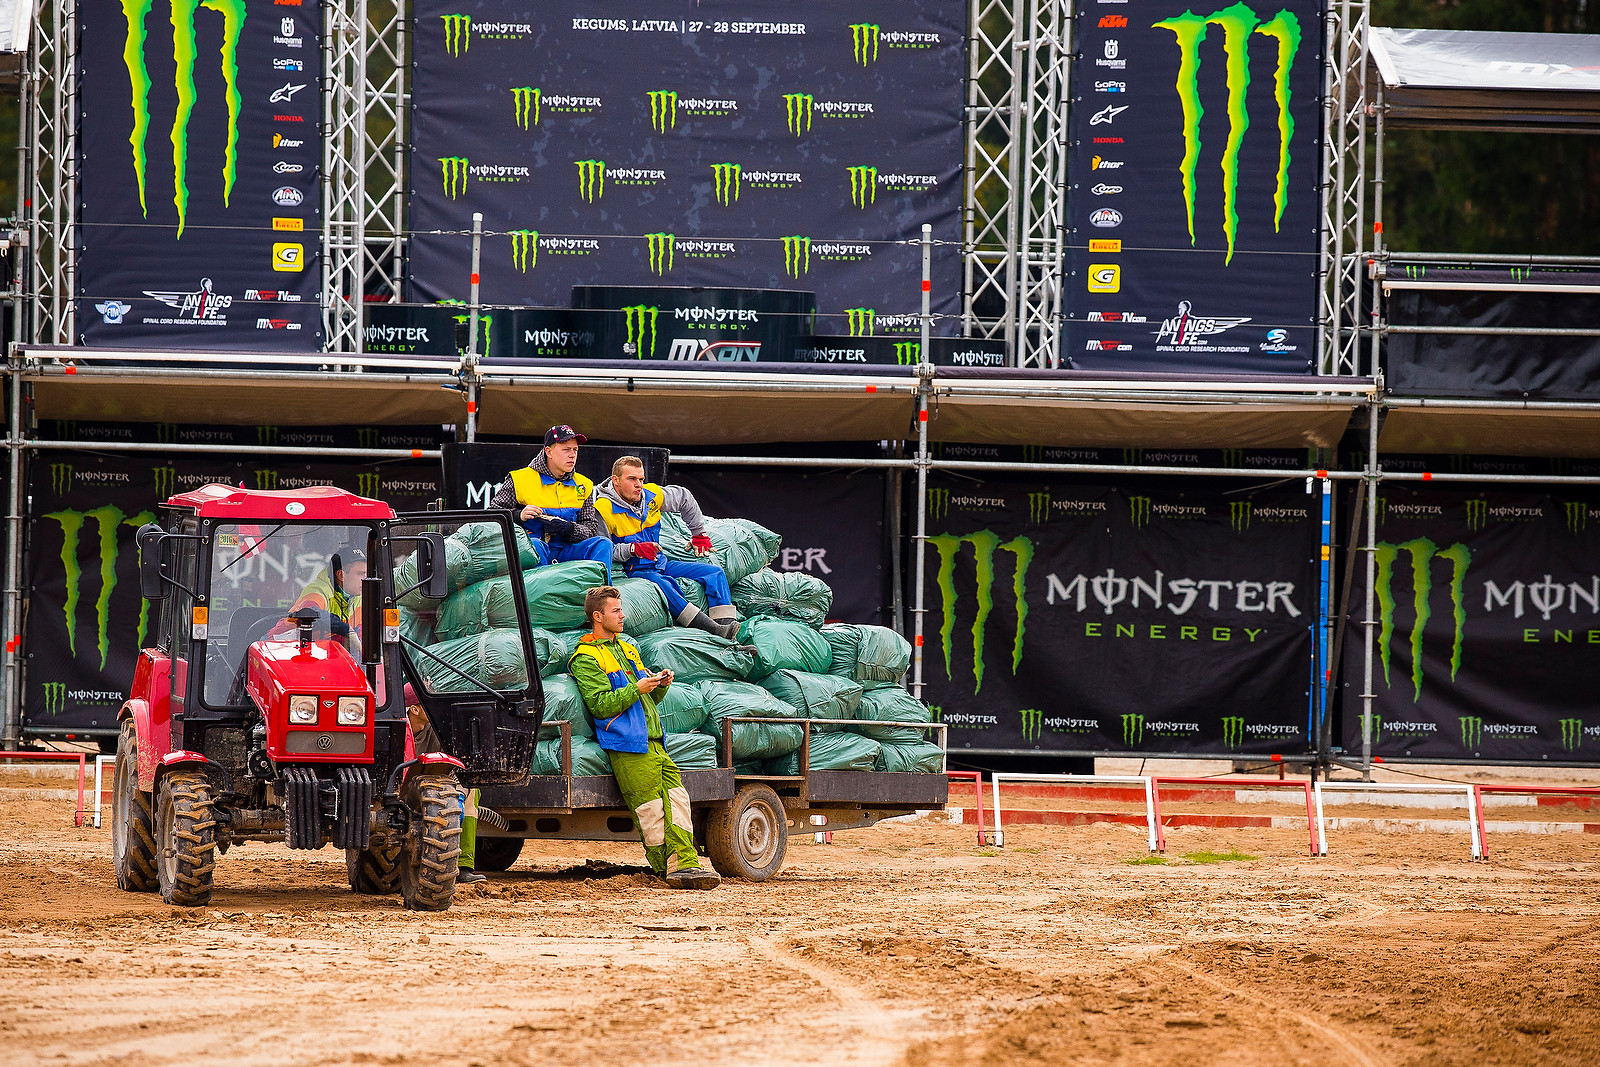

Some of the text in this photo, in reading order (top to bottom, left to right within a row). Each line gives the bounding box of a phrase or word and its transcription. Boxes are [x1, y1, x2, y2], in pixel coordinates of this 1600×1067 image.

[572, 19, 629, 32] KEGUMS,
[632, 20, 678, 31] LATVIA
[688, 22, 703, 32] 27
[714, 22, 729, 33] 28
[731, 22, 806, 34] SEPTEMBER
[1097, 15, 1128, 28] KTM
[472, 21, 532, 34] MONSTER
[881, 31, 940, 43] MONSTER
[273, 58, 303, 66] GoPro
[542, 95, 602, 107] MONSTER
[678, 98, 737, 110] MONSTER
[814, 101, 874, 113] MONSTER
[470, 165, 529, 177] MONSTER
[606, 168, 666, 180] MONSTER
[742, 171, 802, 182] MONSTER
[878, 174, 938, 185] MONSTER
[539, 238, 599, 249] MONSTER
[676, 241, 735, 252] MONSTER
[812, 243, 871, 255] MONSTER
[193, 307, 219, 319] LIFE
[675, 306, 758, 322] MONSTER
[875, 316, 935, 327] MONSTR
[1170, 332, 1200, 345] LIFE
[368, 344, 415, 352] ENERGY
[79, 427, 133, 438] MONSTER
[180, 430, 233, 441] MONSTER
[280, 433, 334, 444] MONSTER
[381, 435, 434, 446] MONSTER
[945, 446, 999, 457] MONSTER
[1045, 449, 1099, 460] MONSTER
[1145, 452, 1199, 463] MONSTER
[1245, 455, 1299, 466] MONSTER
[75, 471, 130, 482] MONSTER
[177, 474, 232, 485] MONSTER
[280, 477, 333, 487] MONSTER
[382, 480, 436, 491] MONSTER
[951, 496, 1005, 507] MONSTER
[1053, 500, 1106, 511] MONSTER
[1153, 504, 1206, 515] MONSTER
[1254, 507, 1307, 518] MONSTER
[1389, 504, 1442, 514] MONSTER
[1489, 506, 1543, 517] MONSTER
[1046, 568, 1301, 618] MONSTER
[1085, 622, 1261, 642] ENERGY
[68, 690, 123, 701] MONSTER
[944, 712, 997, 725] MONSTER
[1044, 716, 1099, 729] MONSTER
[1146, 720, 1199, 732] MONSTER
[1246, 723, 1300, 735] MONSTER
[1383, 721, 1437, 732] MONSTER
[1483, 723, 1538, 734] MONSTER
